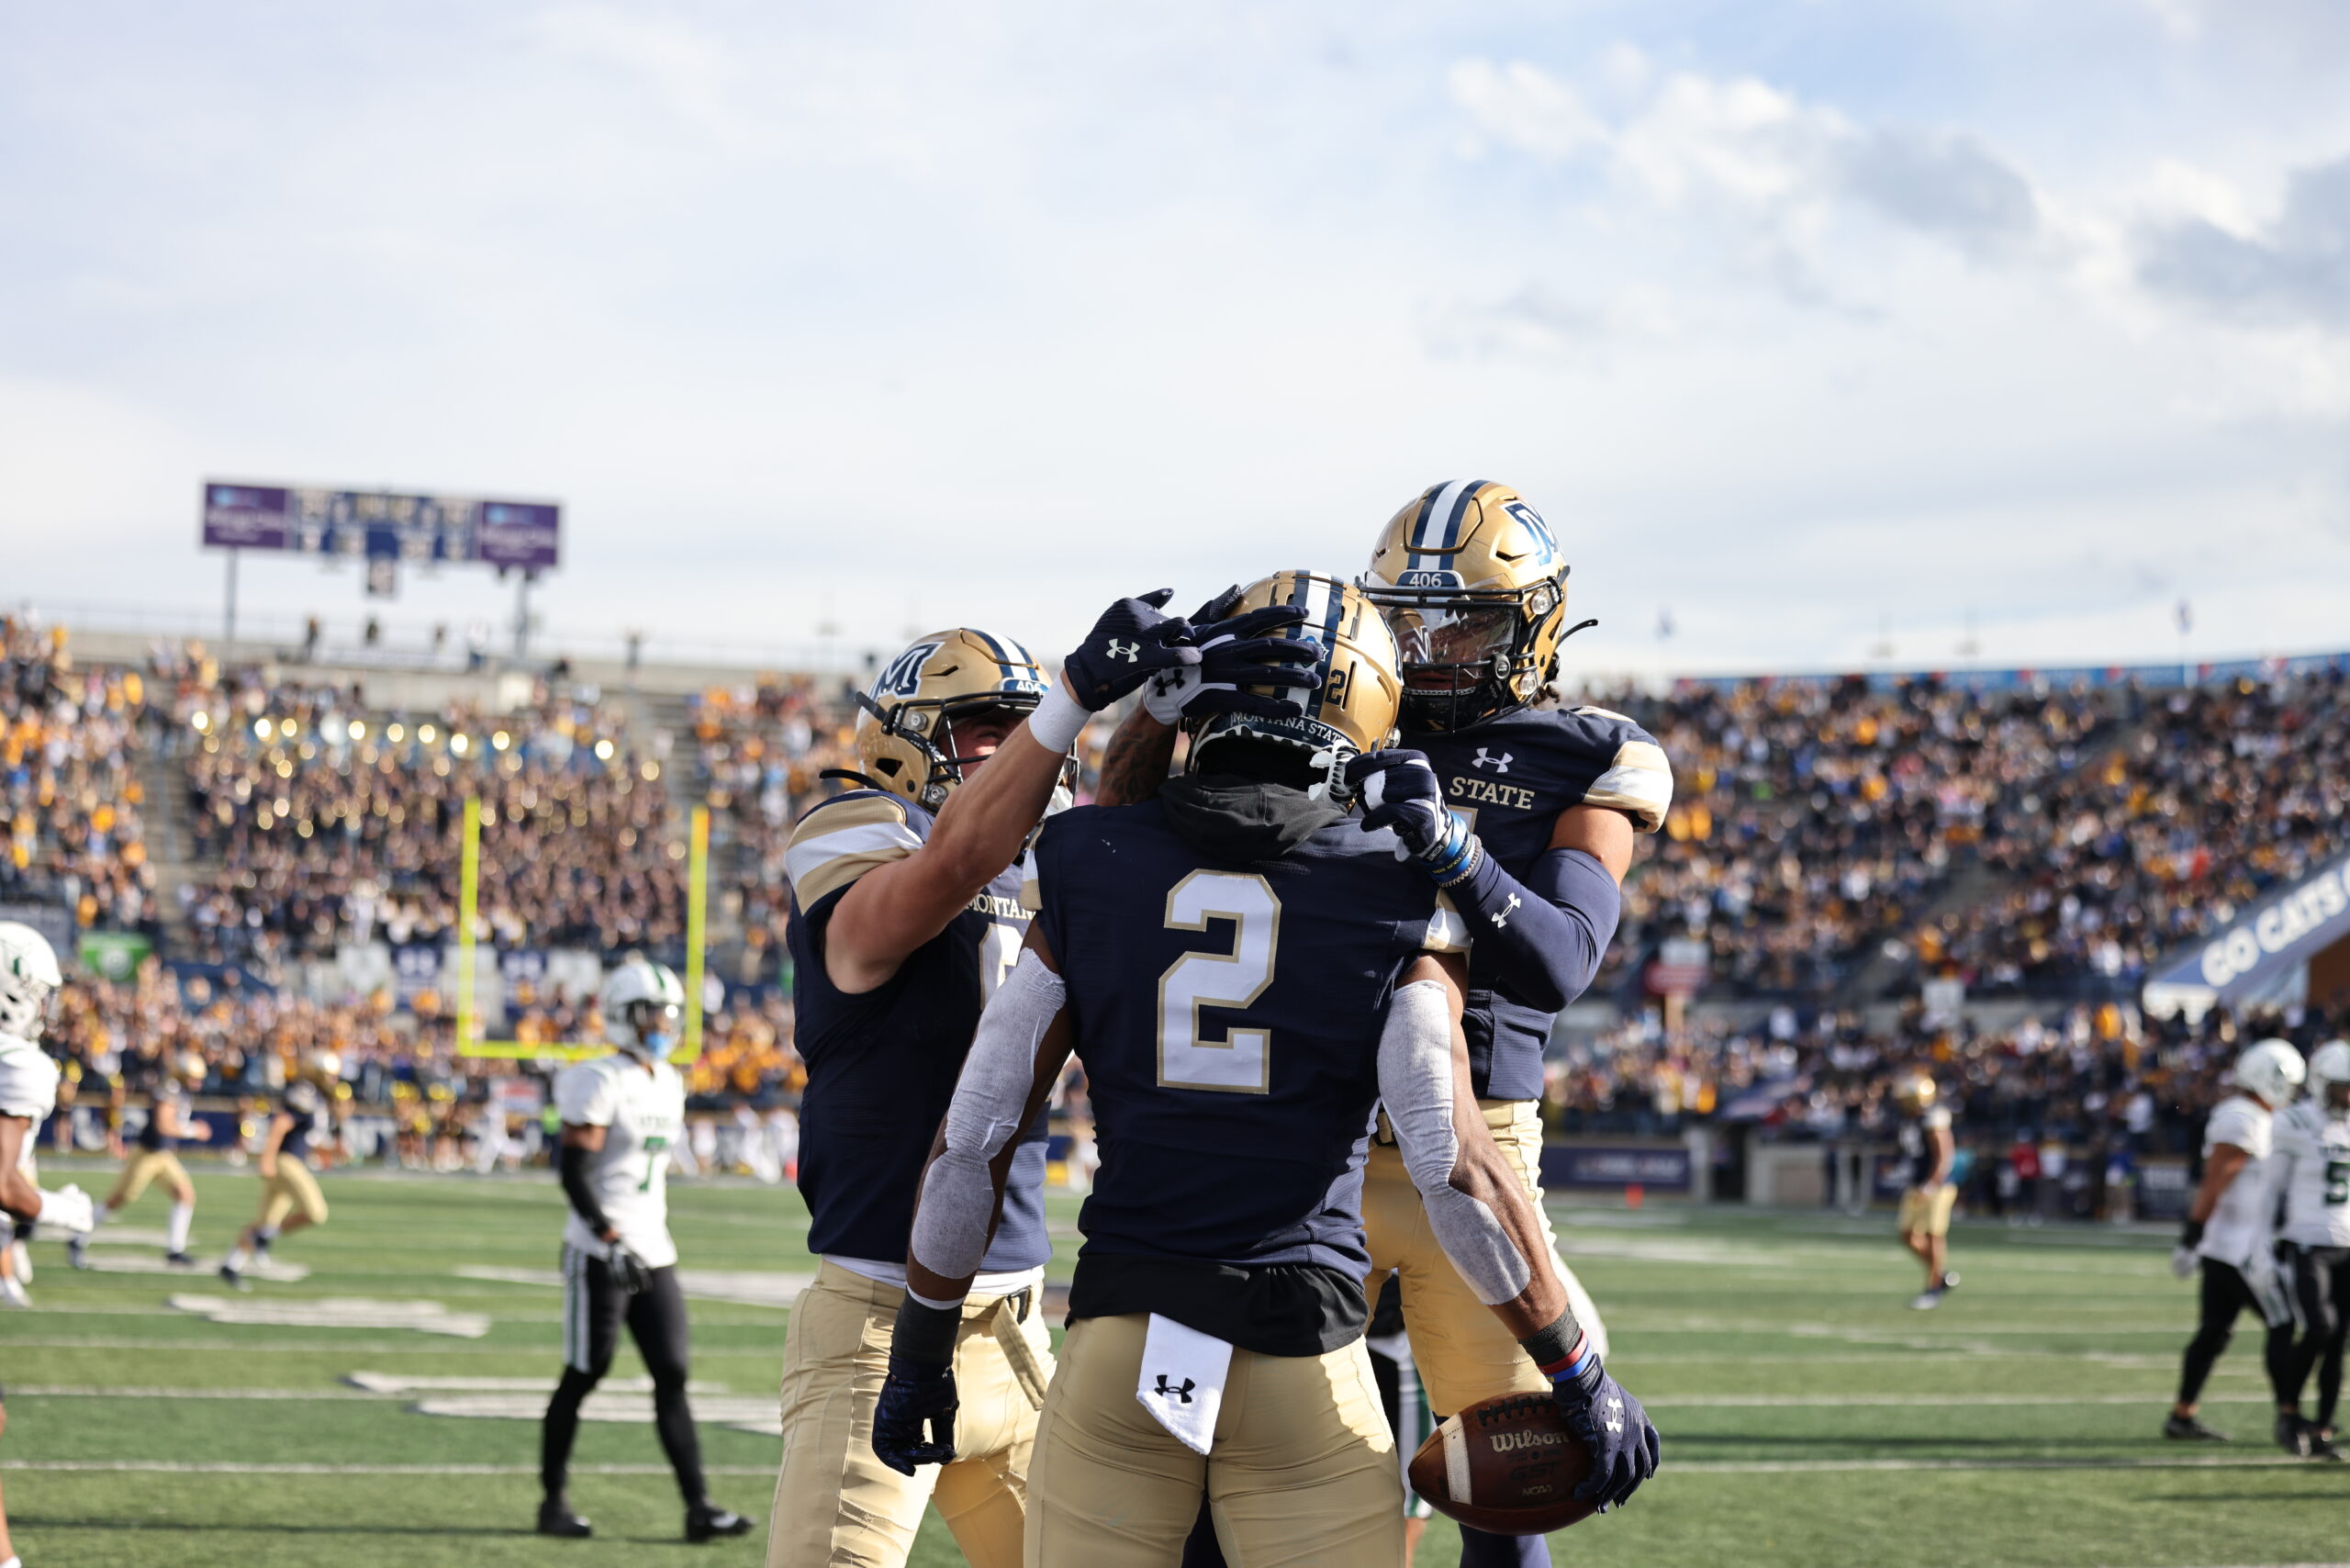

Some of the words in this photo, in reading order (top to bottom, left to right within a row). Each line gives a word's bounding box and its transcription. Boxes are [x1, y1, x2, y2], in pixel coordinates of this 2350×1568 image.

[1409, 573, 1441, 588] 406
[1325, 669, 1346, 705] 2
[1449, 777, 1535, 810] STATE
[2201, 925, 2260, 987] GO
[2255, 870, 2347, 954] CATS
[1158, 868, 1282, 1094] 2
[638, 1136, 667, 1192] 7
[1489, 1428, 1570, 1453] Wilson
[1522, 1484, 1553, 1495] NCAA
